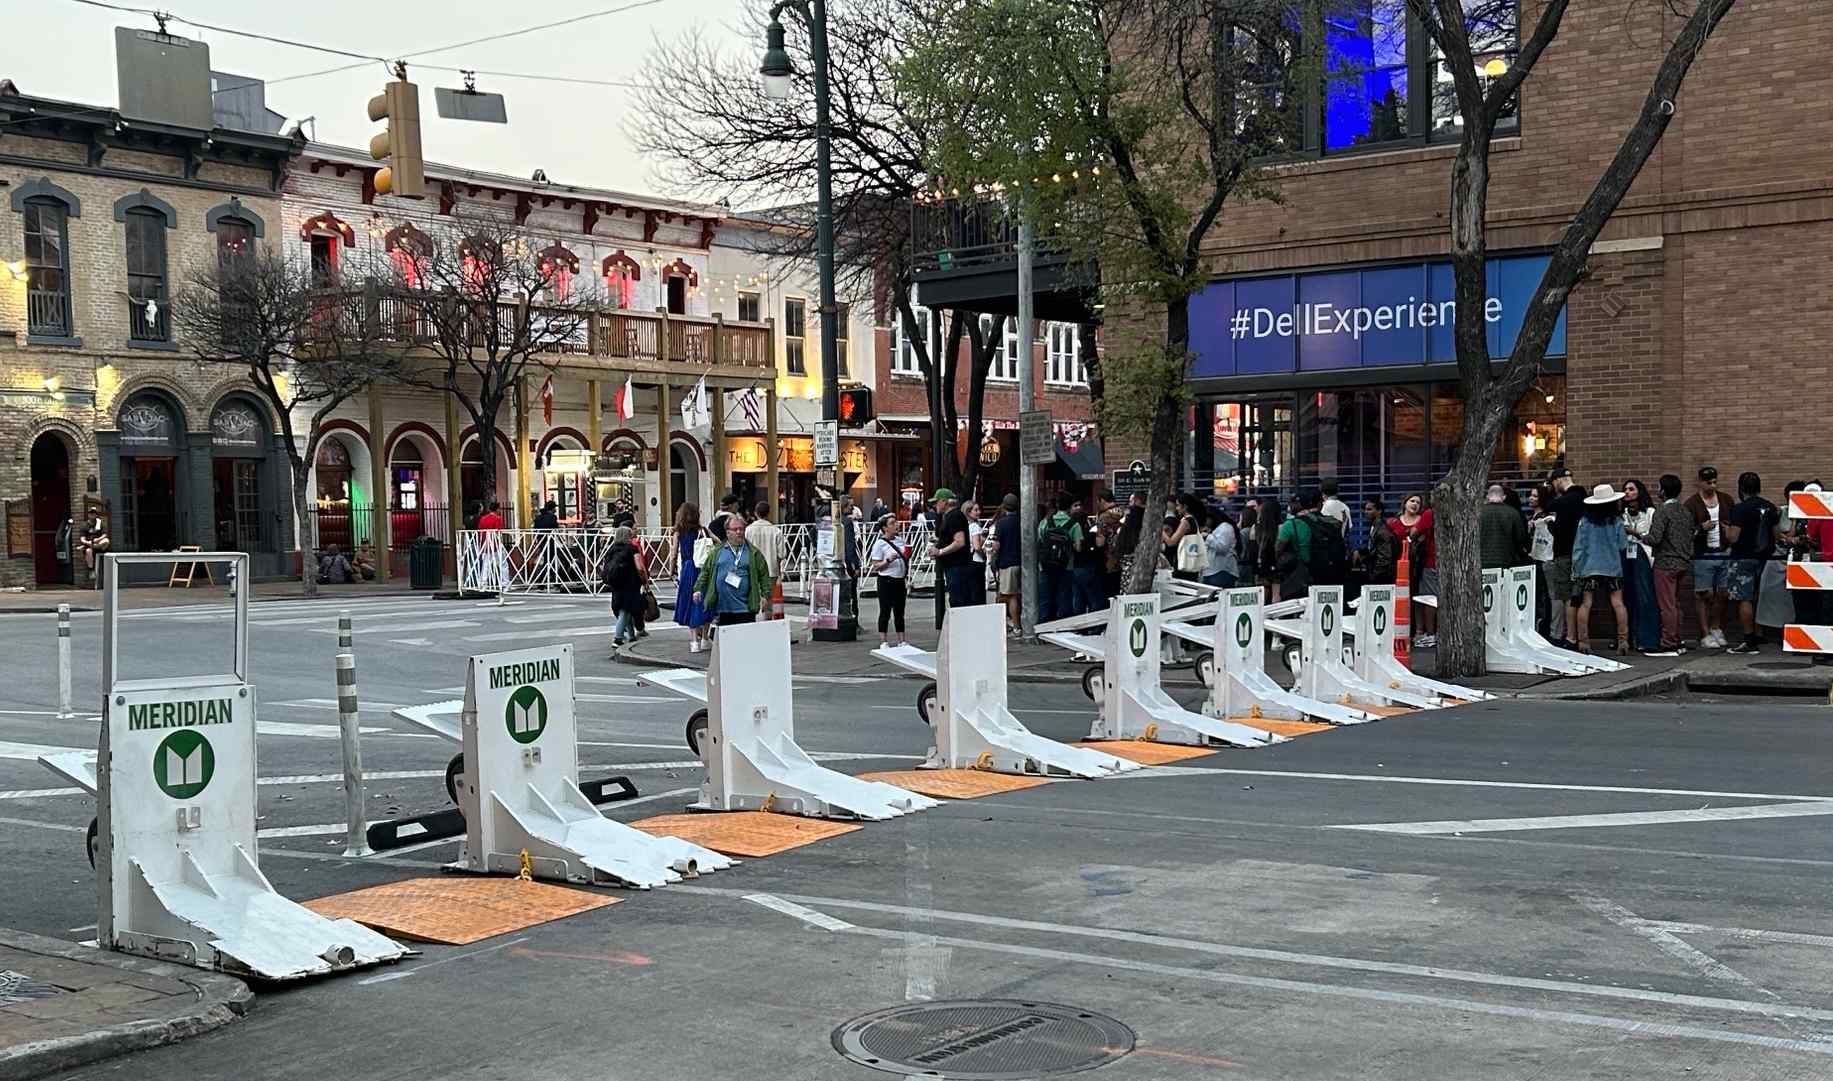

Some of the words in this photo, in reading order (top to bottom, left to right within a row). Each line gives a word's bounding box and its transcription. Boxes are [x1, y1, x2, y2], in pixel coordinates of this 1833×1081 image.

[1230, 296, 1503, 340] #DellExperiene
[728, 450, 752, 464] THE
[1123, 601, 1154, 618] MERIDIAN
[1230, 591, 1259, 607] MERIDIAN
[489, 658, 560, 689] MERIDIAN
[128, 698, 233, 731] MERIDIAN
